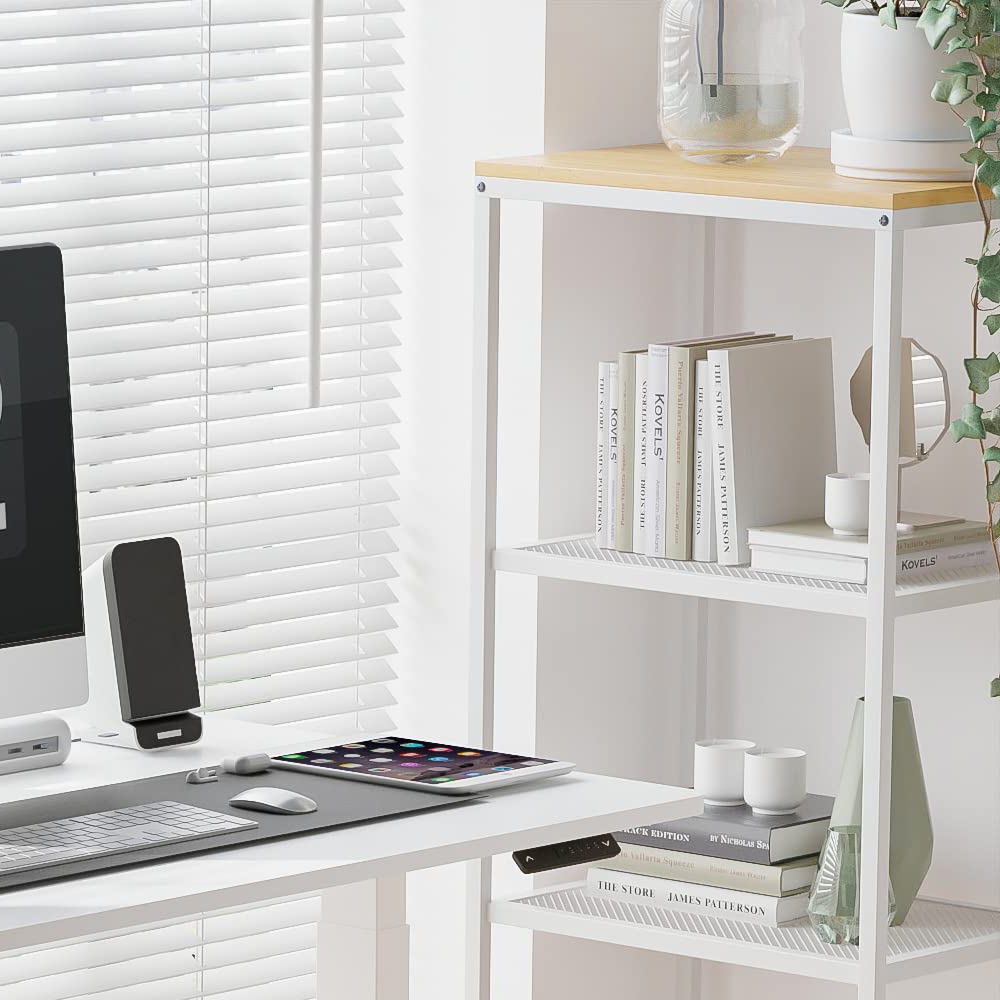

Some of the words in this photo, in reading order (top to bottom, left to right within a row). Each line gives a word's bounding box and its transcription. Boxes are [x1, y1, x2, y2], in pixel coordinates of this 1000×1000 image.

[714, 364, 722, 384] THE
[653, 393, 665, 461] KOVELS'
[716, 391, 724, 430] STORE
[610, 408, 619, 464] KOVELS'
[717, 444, 726, 481] JAMES
[720, 486, 731, 553] PATTERSON
[901, 555, 939, 572] KOVELS'
[651, 830, 691, 843] EDITION
[597, 880, 617, 893] THE
[621, 884, 656, 899] STORE
[667, 892, 702, 906] JAMES
[705, 898, 766, 917] PATTERSON
